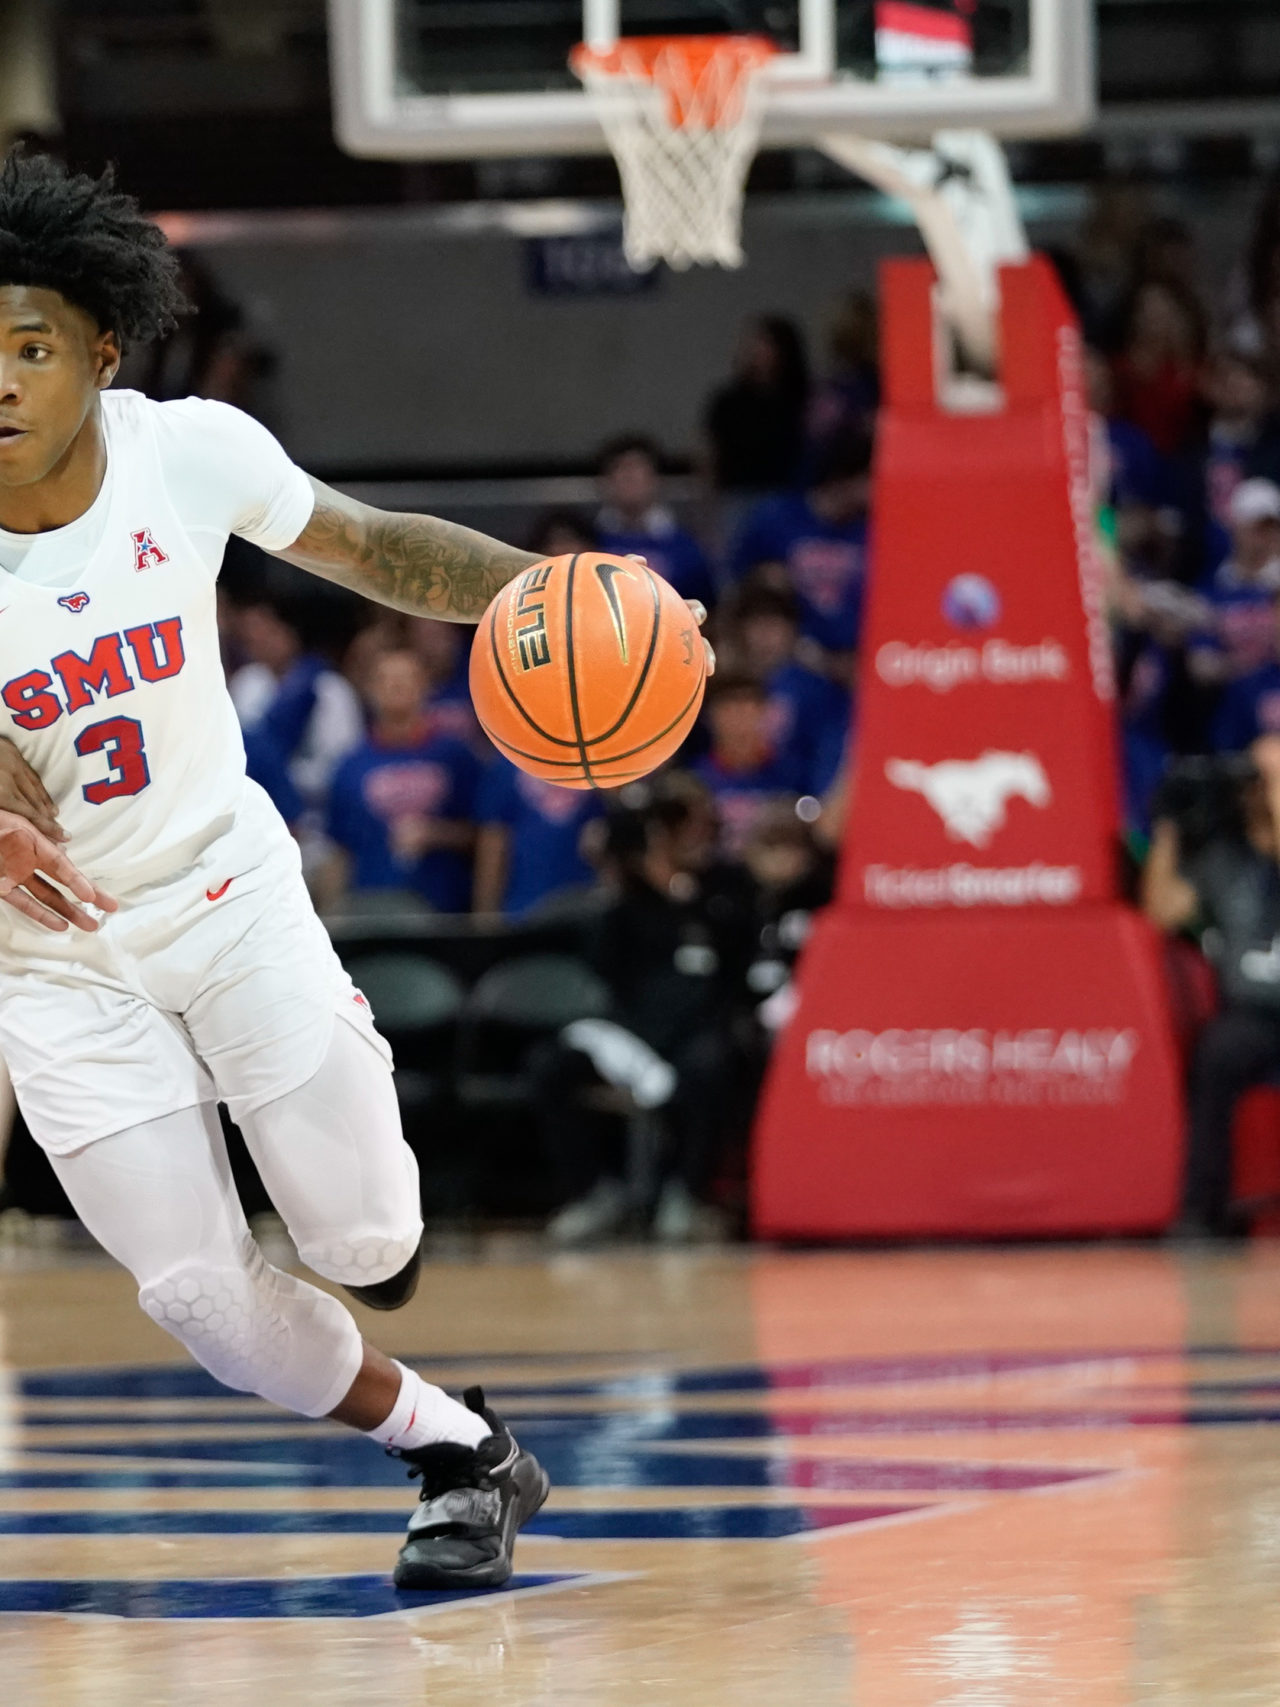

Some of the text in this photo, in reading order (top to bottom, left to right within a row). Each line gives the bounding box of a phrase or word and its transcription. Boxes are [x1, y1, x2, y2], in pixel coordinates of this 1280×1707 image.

[516, 565, 553, 672] ELITE
[982, 637, 1069, 684] Bank
[1, 615, 186, 731] SMU
[74, 715, 151, 806] 3
[805, 1028, 1139, 1080] ROGERS HEALY
